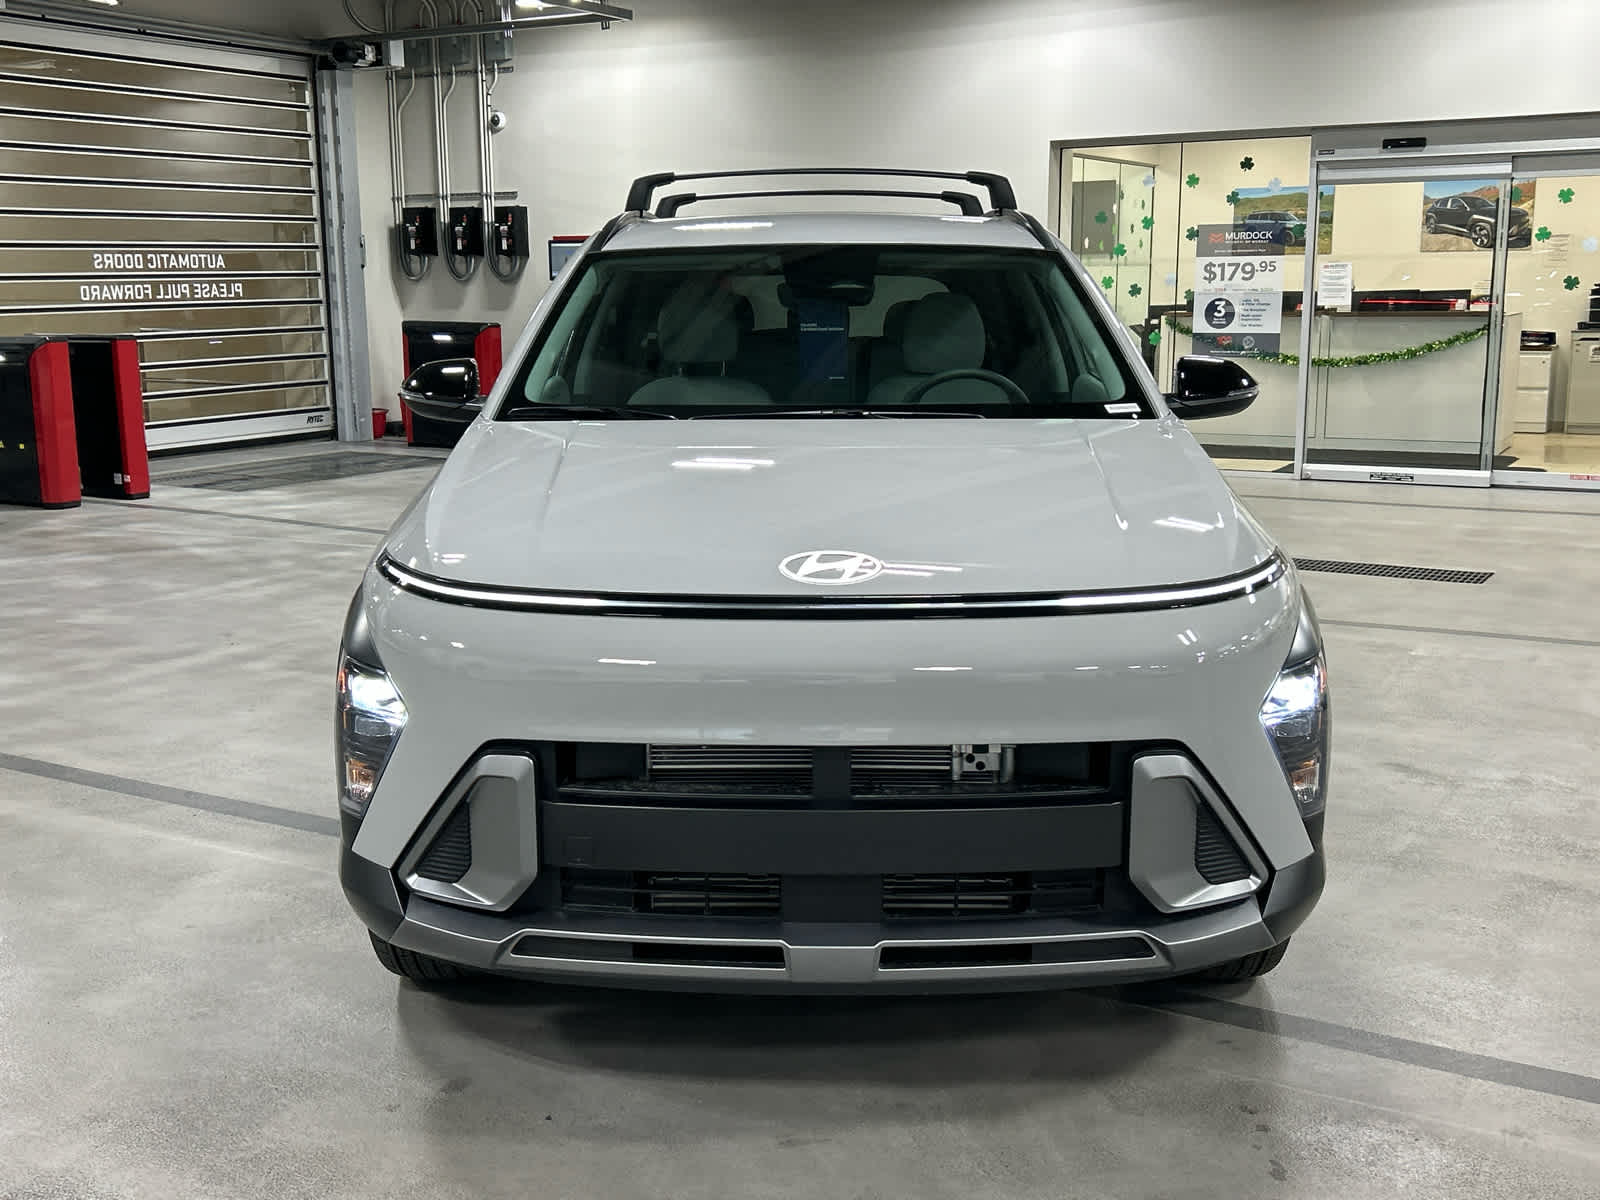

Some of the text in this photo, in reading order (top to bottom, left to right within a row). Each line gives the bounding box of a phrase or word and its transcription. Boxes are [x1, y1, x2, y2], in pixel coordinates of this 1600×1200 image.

[1225, 231, 1273, 241] MURDOCK
[1202, 260, 1277, 284] $179.95
[1213, 300, 1226, 317] 3
